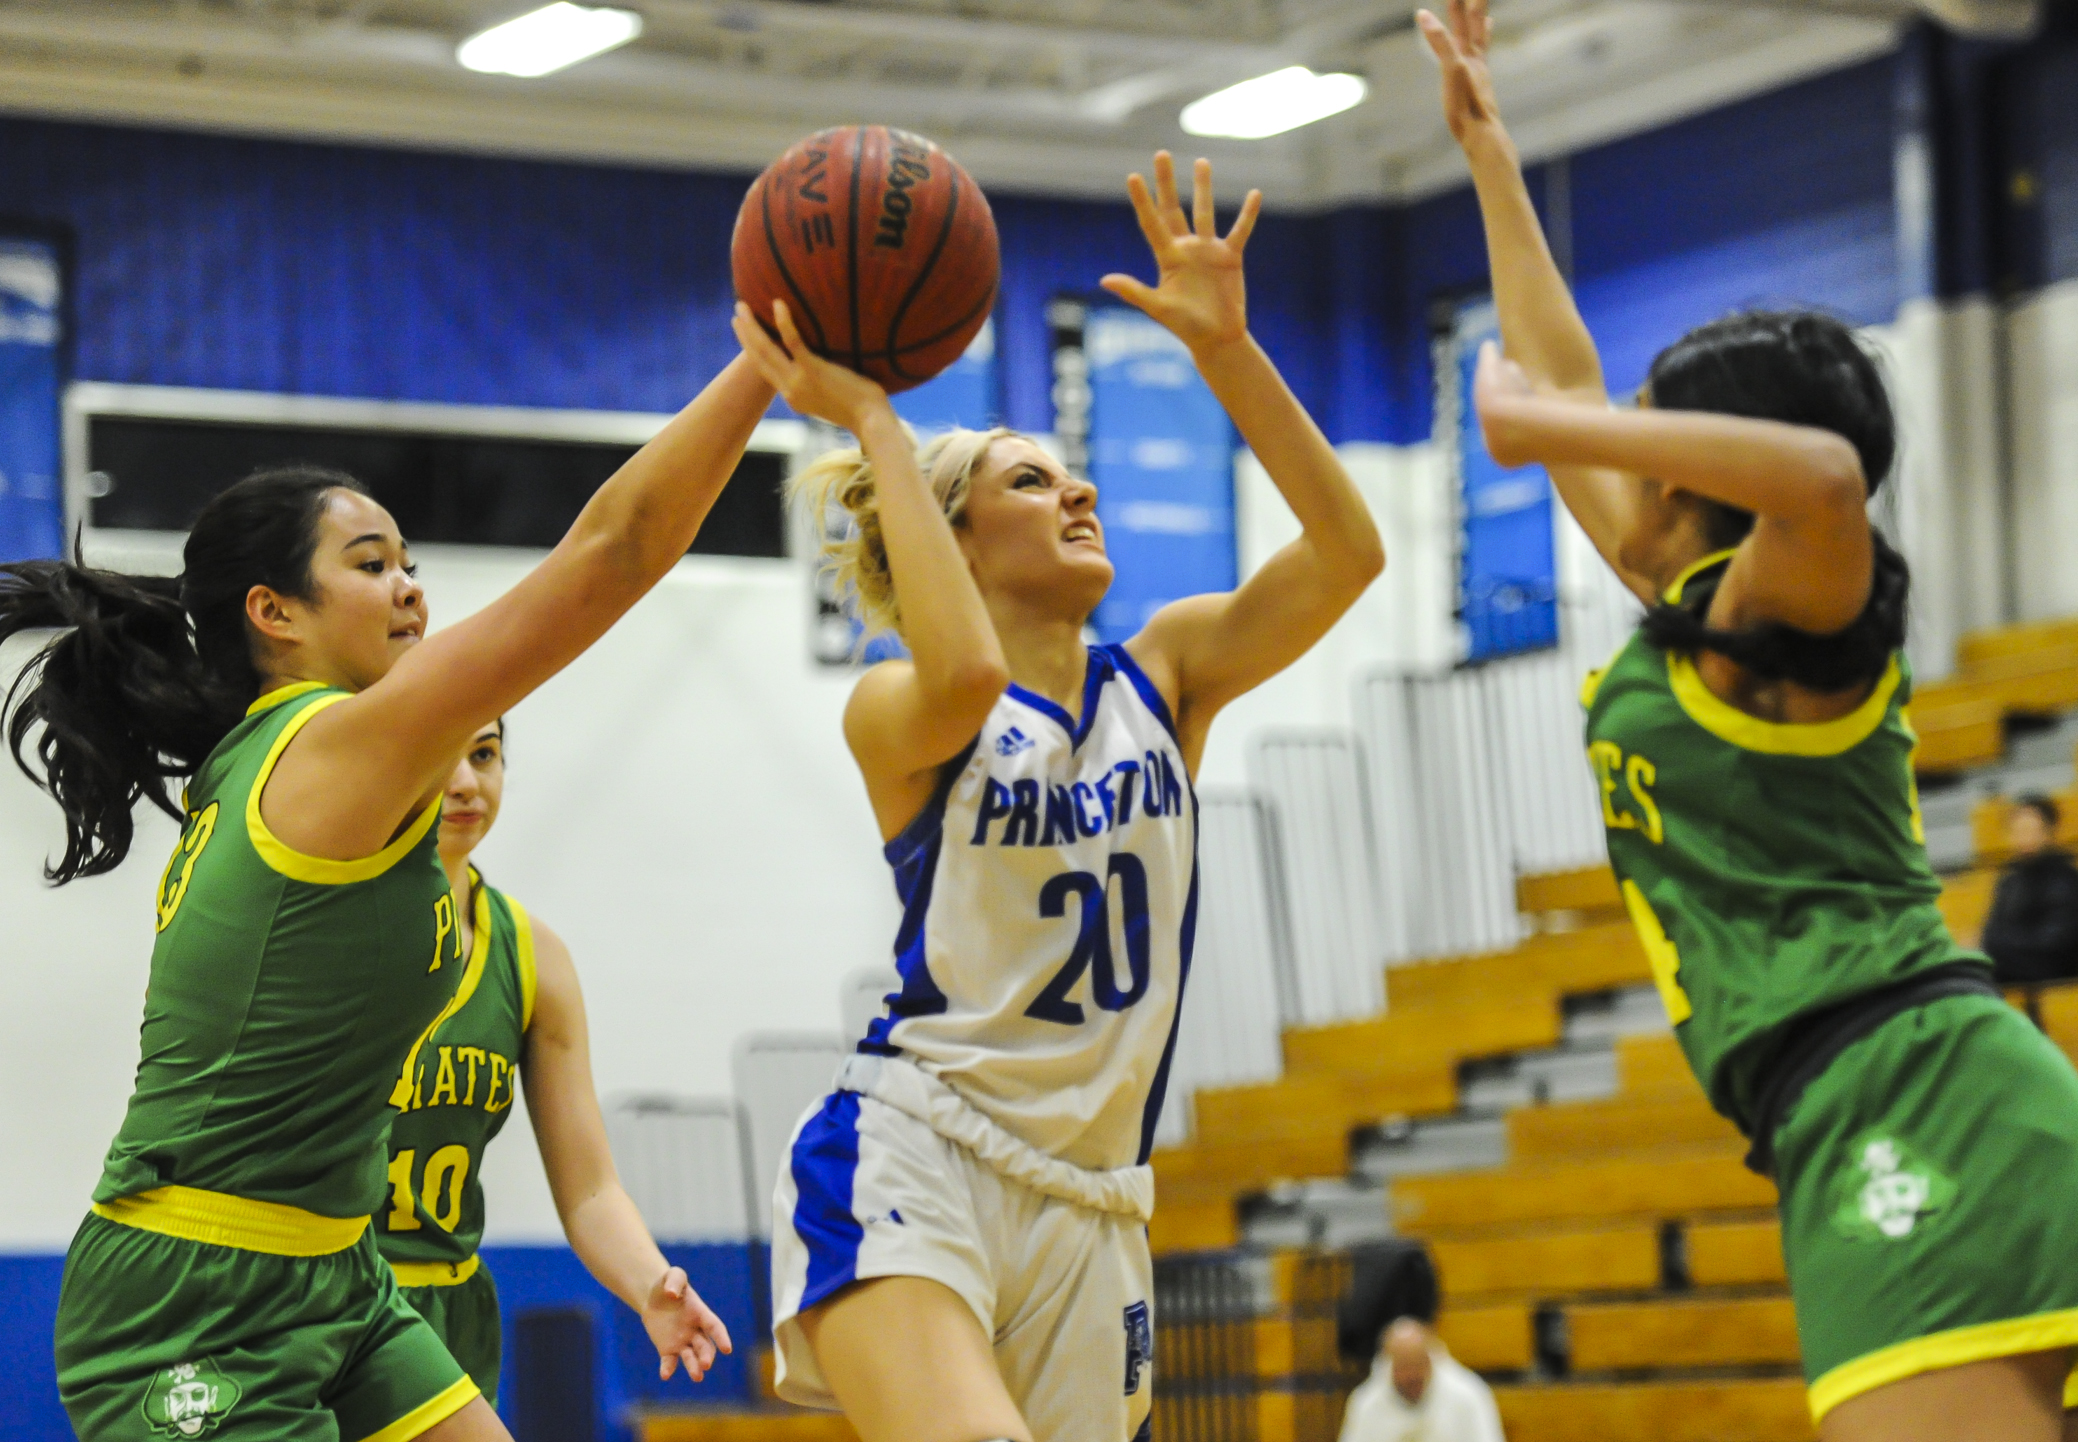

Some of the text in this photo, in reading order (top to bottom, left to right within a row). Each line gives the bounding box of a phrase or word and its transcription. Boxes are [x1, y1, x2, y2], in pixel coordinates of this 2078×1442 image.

[799, 134, 836, 255] AVE
[970, 749, 1182, 847] PRNCETON
[1024, 852, 1151, 1026] 20
[387, 1144, 470, 1233] 10
